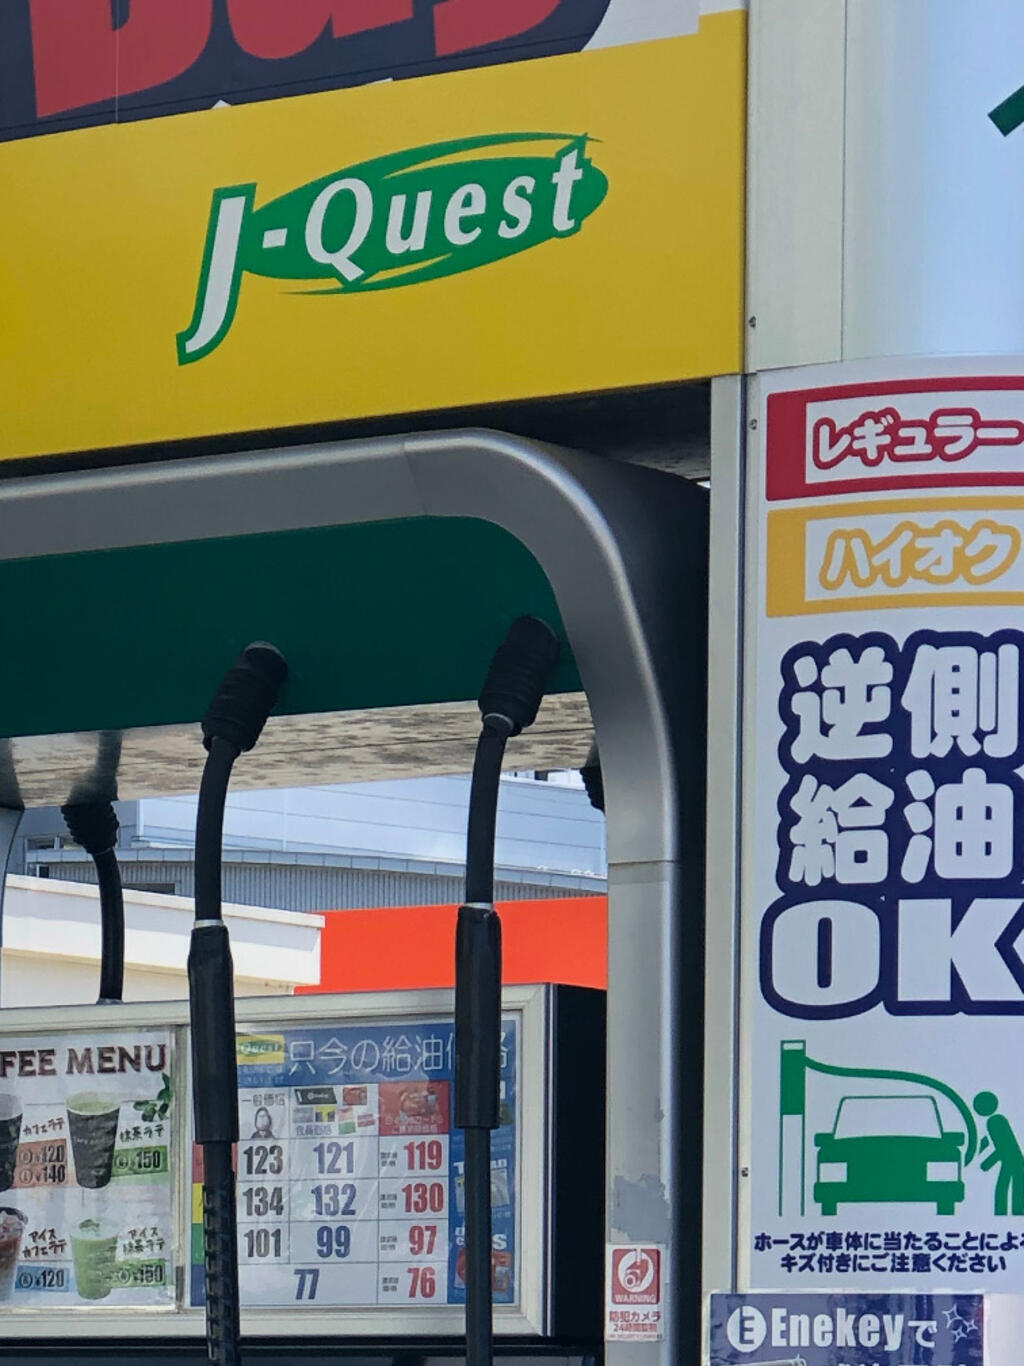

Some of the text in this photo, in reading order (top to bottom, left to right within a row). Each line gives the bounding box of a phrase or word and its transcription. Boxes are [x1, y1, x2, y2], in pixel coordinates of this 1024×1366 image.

[179, 136, 588, 362] J-Quest
[814, 407, 1024, 469] レギュラー
[820, 519, 1021, 590] ハイオク
[782, 634, 1024, 764] 逆側
[781, 765, 1020, 888] 給油
[764, 897, 1024, 1012] OK
[66, 1044, 167, 1074] MENU
[243, 1145, 284, 1175] 123
[314, 1141, 354, 1174] 121
[404, 1140, 443, 1170] 119
[243, 1187, 284, 1217] 134
[312, 1184, 357, 1216] 132
[402, 1182, 444, 1213] 130
[244, 1229, 282, 1258] 101
[317, 1226, 351, 1258] 99
[409, 1225, 437, 1254] 97
[294, 1268, 320, 1299] 77
[407, 1267, 436, 1298] 76
[781, 1253, 1006, 1274] キズ付きにご注意ください
[609, 1311, 661, 1322] 防犯カメラ
[771, 1306, 938, 1352] Enekeyで
